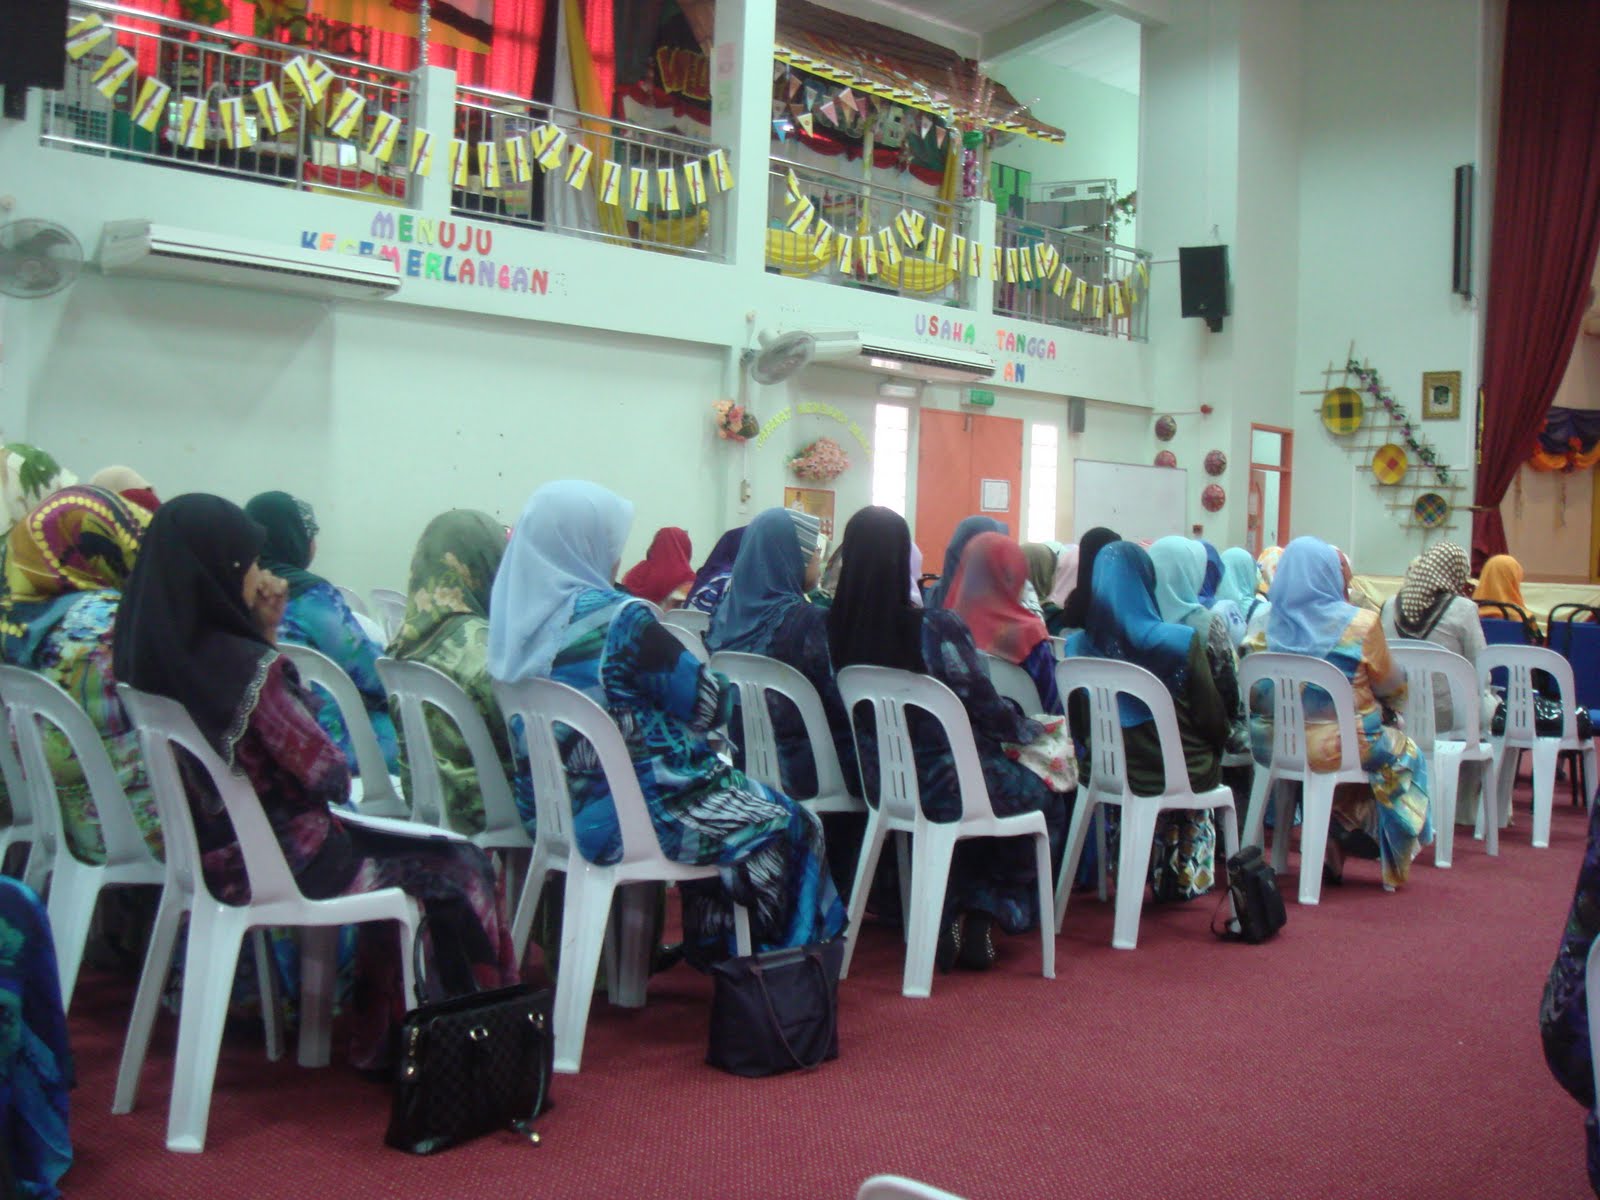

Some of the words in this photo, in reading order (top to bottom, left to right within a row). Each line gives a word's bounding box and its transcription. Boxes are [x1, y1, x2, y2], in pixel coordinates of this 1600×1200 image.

[371, 210, 492, 255] MENUJU
[915, 315, 976, 345] USAHA
[996, 330, 1057, 360] TANGGA
